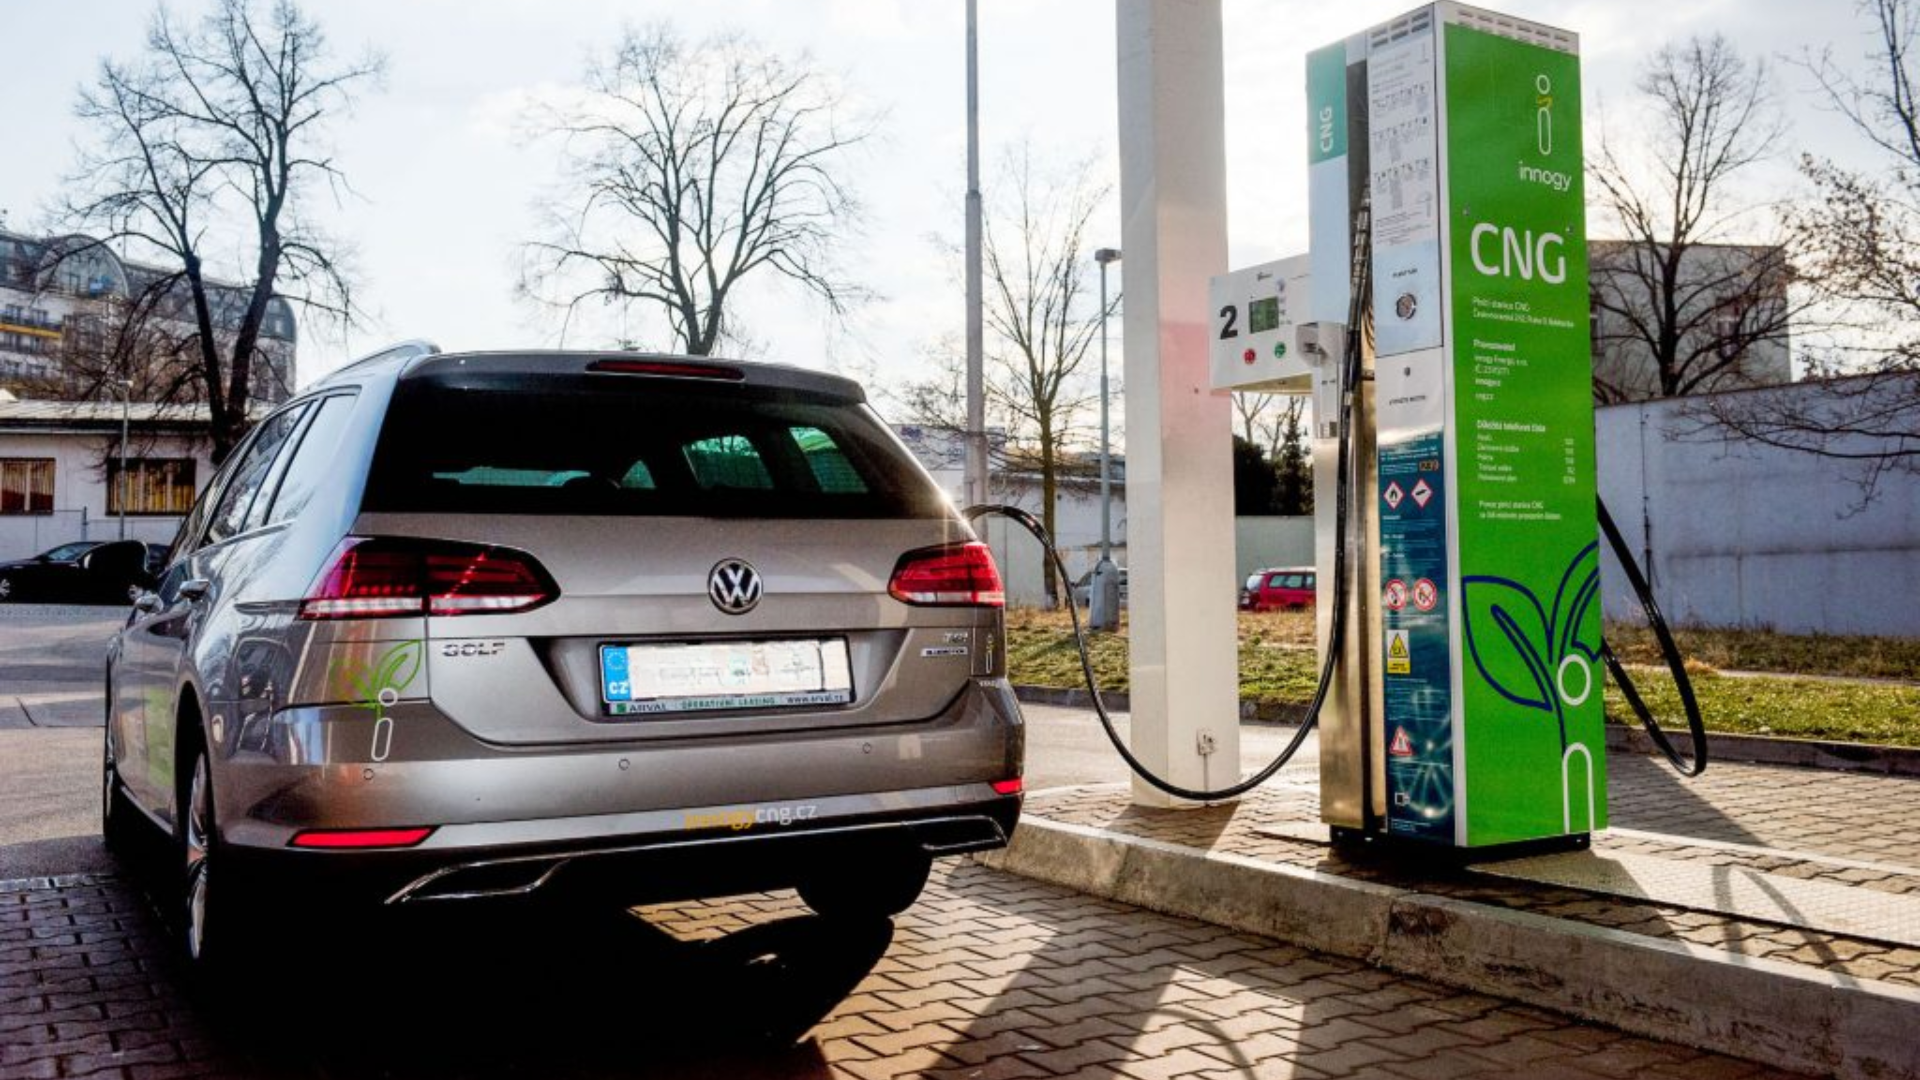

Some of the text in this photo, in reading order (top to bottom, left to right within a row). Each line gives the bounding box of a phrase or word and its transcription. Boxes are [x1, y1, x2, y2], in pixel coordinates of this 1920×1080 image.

[1319, 106, 1334, 153] CNG
[1519, 160, 1573, 191] innogy
[1470, 222, 1567, 284] CNG
[1219, 304, 1239, 340] 2
[710, 560, 761, 610] VW
[442, 642, 505, 657] GOLF
[608, 681, 629, 695] CZ
[629, 703, 667, 713] ARVAL
